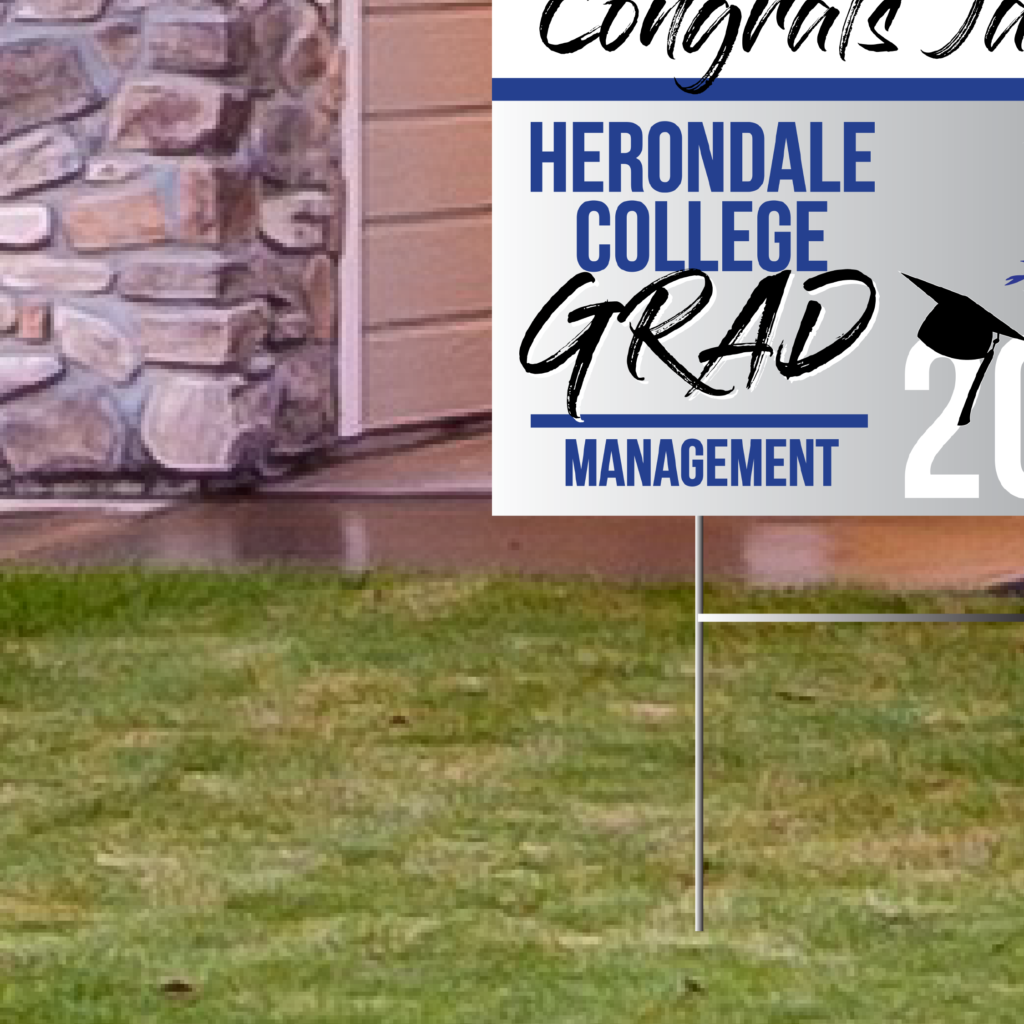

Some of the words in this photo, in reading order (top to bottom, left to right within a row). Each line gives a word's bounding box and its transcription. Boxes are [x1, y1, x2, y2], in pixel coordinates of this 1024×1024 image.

[529, 121, 876, 194] HERONDALE
[575, 200, 829, 273] COLLEGE
[518, 267, 880, 423] GRAD
[564, 437, 840, 488] MANAGEMENT
